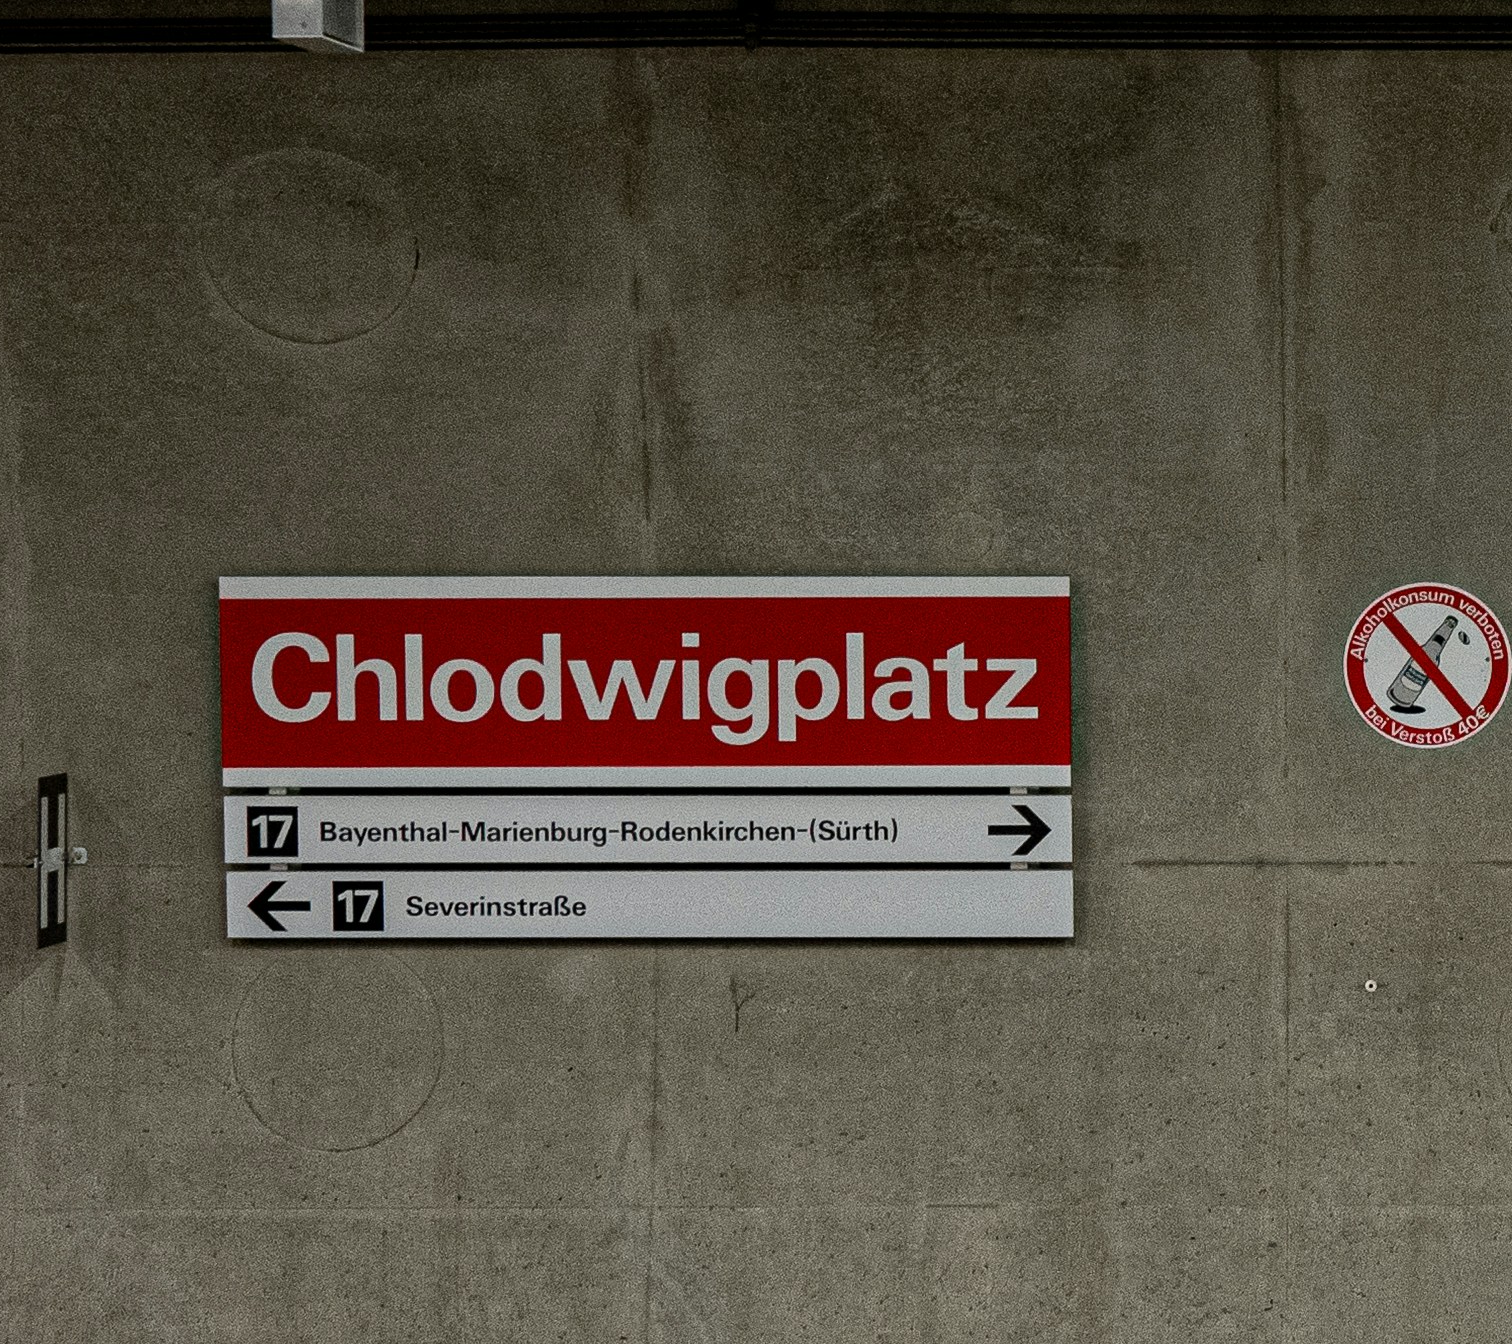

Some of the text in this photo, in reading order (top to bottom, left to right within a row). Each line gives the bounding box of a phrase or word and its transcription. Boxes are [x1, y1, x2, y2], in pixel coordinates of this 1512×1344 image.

[1350, 590, 1504, 660] Alkoholkonsum verboten
[251, 632, 1039, 746] Chlodwigplatz
[1365, 704, 1490, 744] bei Verstoß 40€
[251, 813, 899, 849] 17 Bayenthal-Marienburg-Rodenkirchen-(Sürth)
[337, 889, 587, 923] 17 Severinstraße
